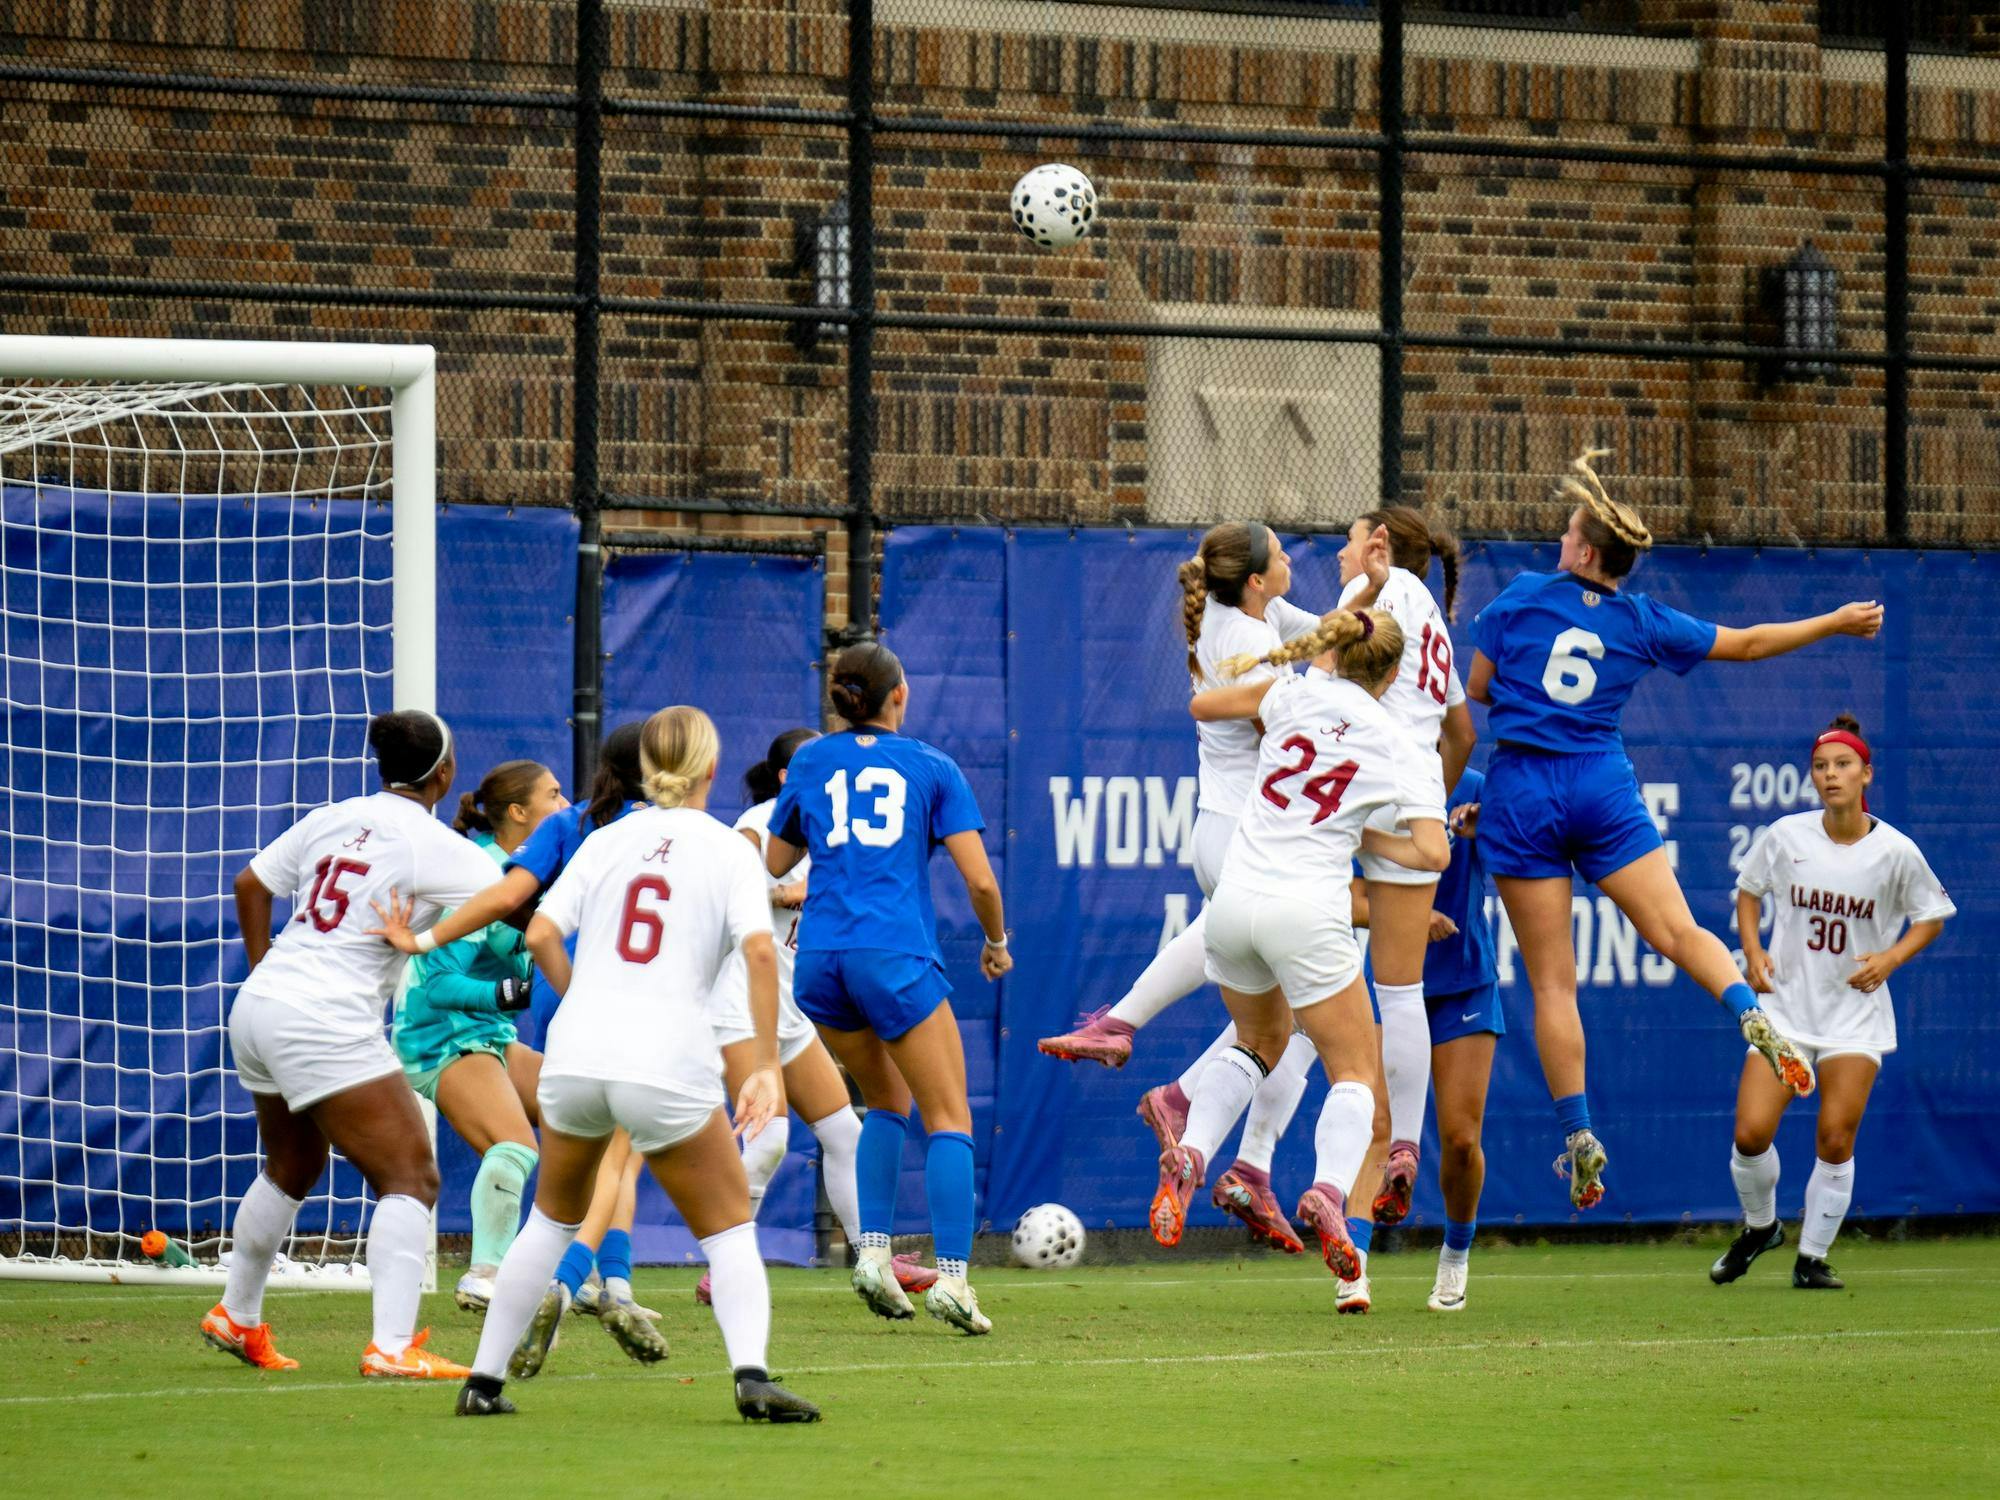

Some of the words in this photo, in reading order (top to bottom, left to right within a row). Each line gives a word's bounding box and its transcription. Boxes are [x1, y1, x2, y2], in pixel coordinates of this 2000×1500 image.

[1416, 622, 1451, 705] 19
[1542, 627, 1605, 706] 6
[825, 766, 907, 848] 13
[1261, 733, 1360, 826] 24
[1050, 775, 1197, 868] WOM
[294, 854, 372, 933] 15
[615, 872, 672, 965] 6
[1807, 914, 1848, 955] 30
